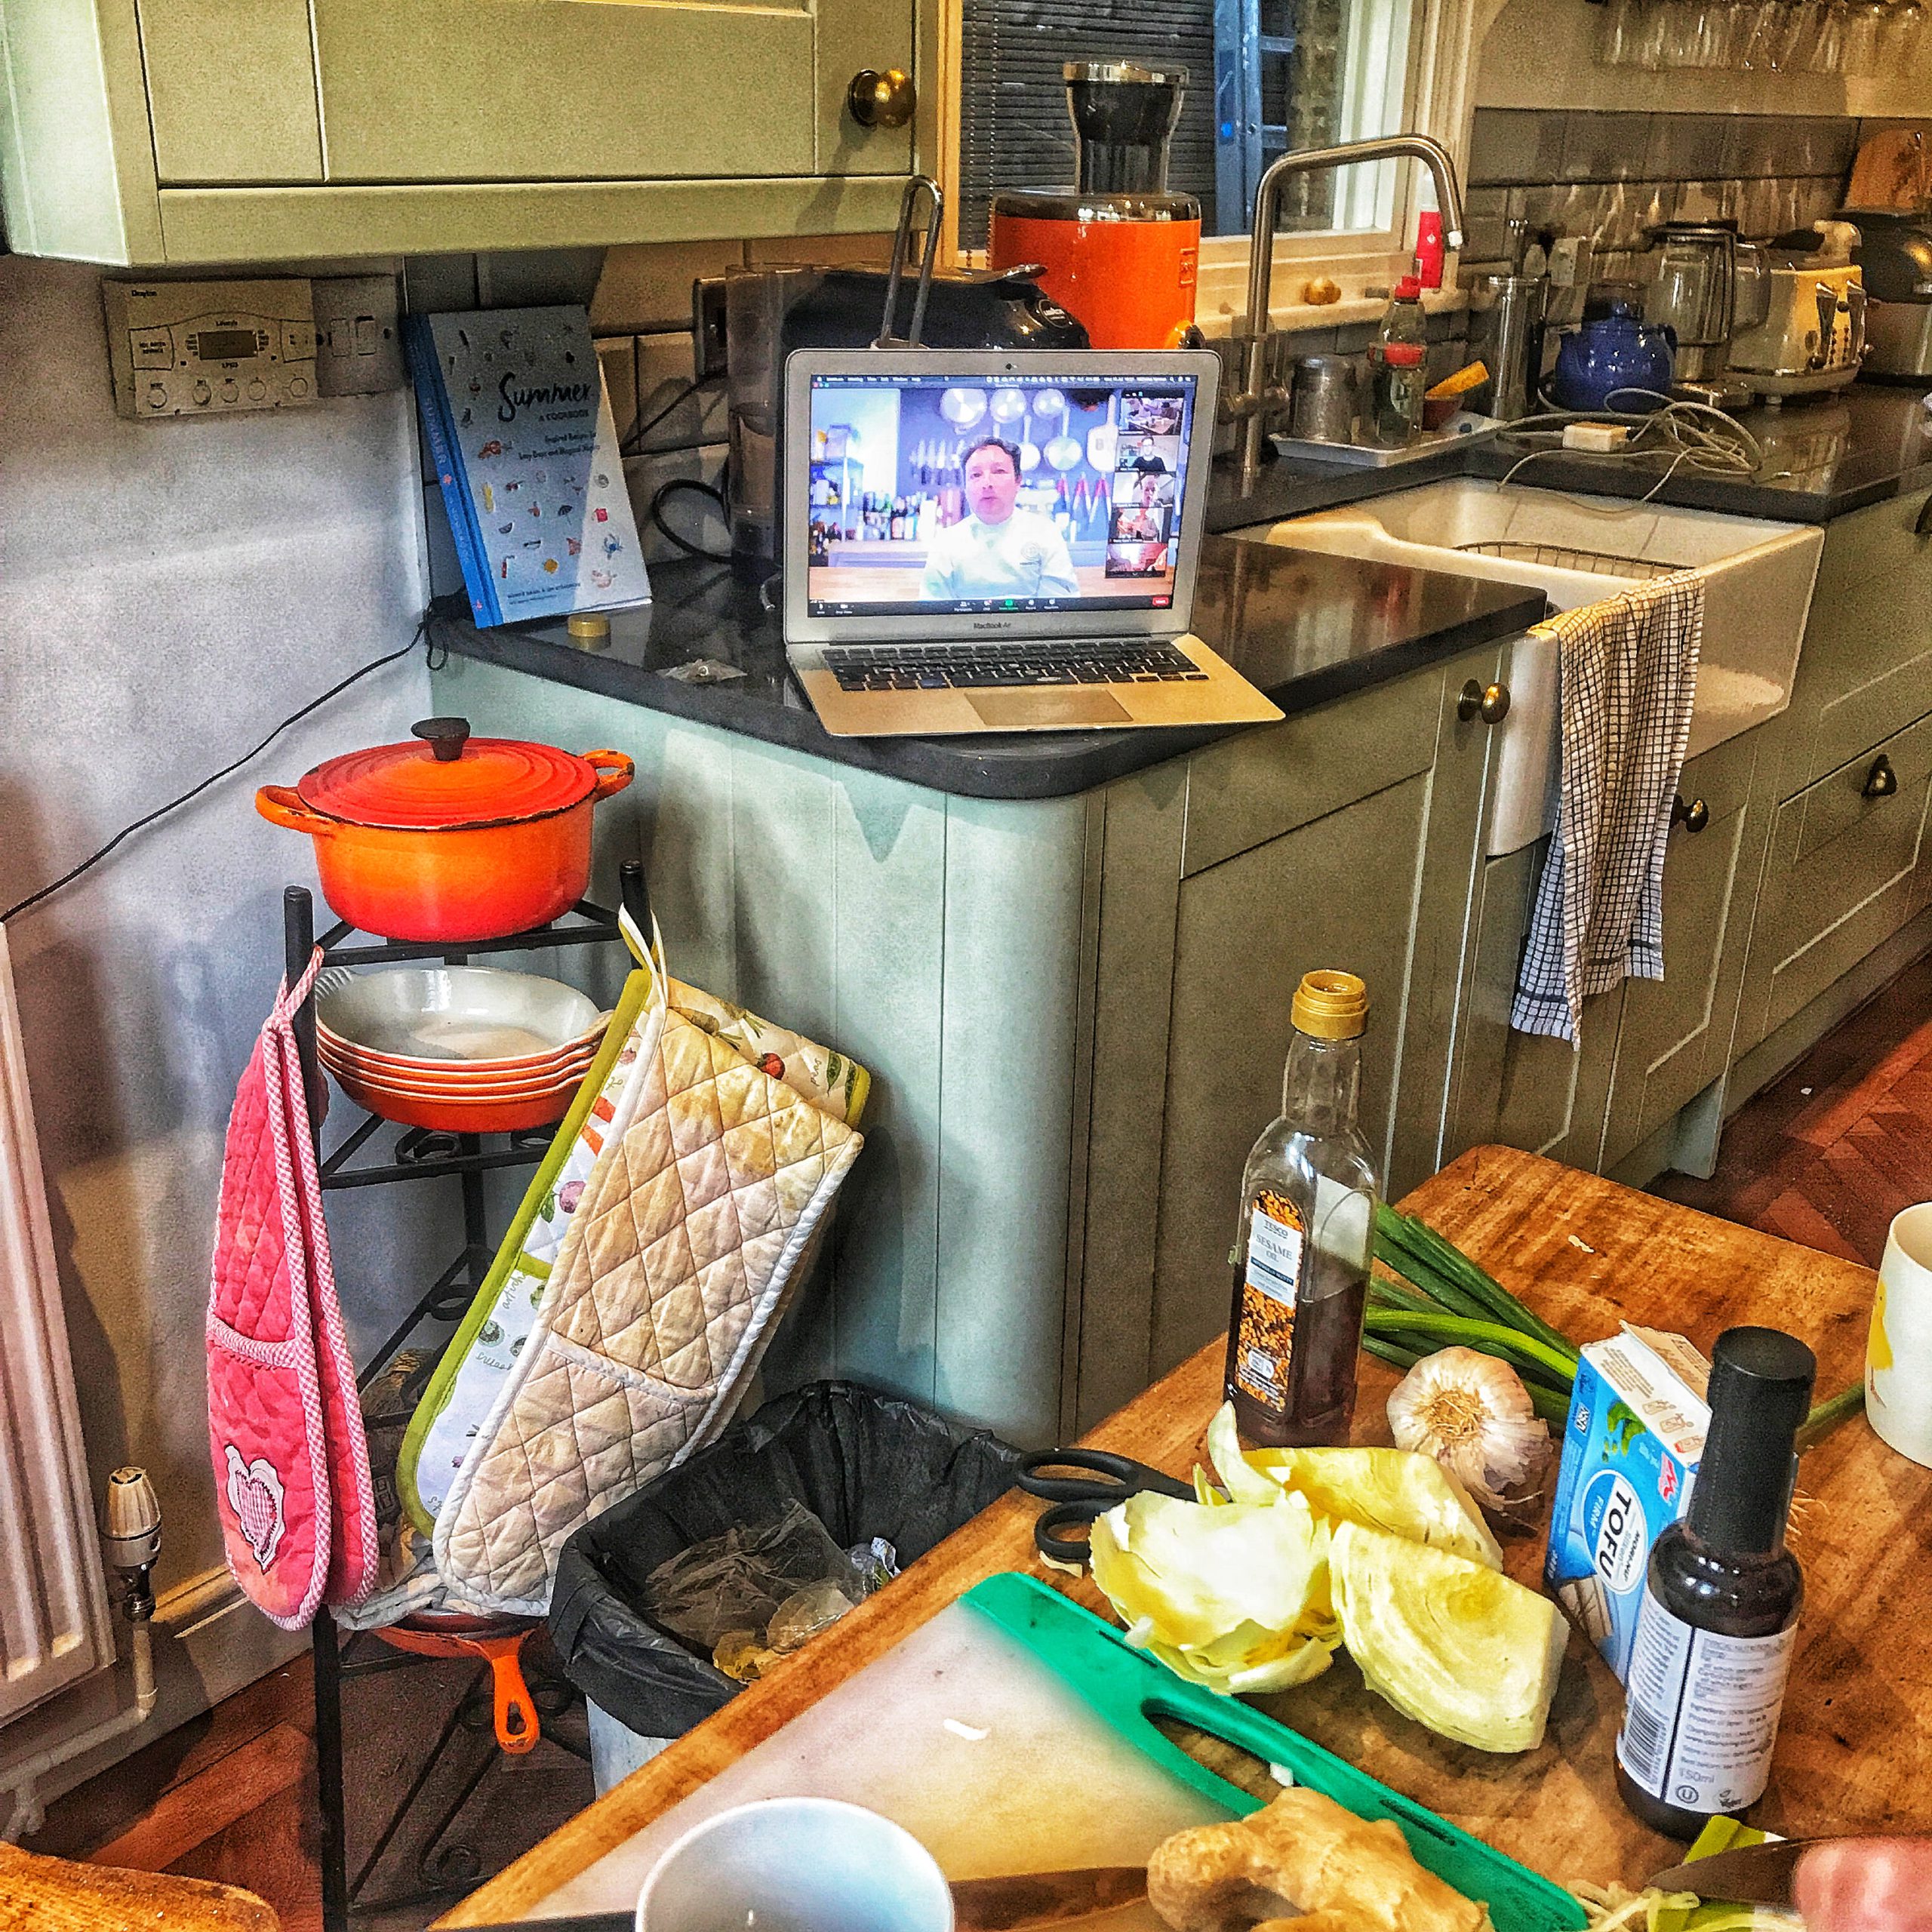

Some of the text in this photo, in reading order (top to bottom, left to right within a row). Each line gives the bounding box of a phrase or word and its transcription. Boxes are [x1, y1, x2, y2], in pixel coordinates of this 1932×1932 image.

[498, 371, 591, 423] Summer
[1264, 1220, 1289, 1237] TESCO
[1256, 1233, 1293, 1261] SESAME
[1266, 1251, 1279, 1263] OIL
[1590, 1495, 1604, 1529] FIRM
[1599, 1491, 1632, 1580] TOFU
[1679, 1767, 1715, 1783] 150ml
